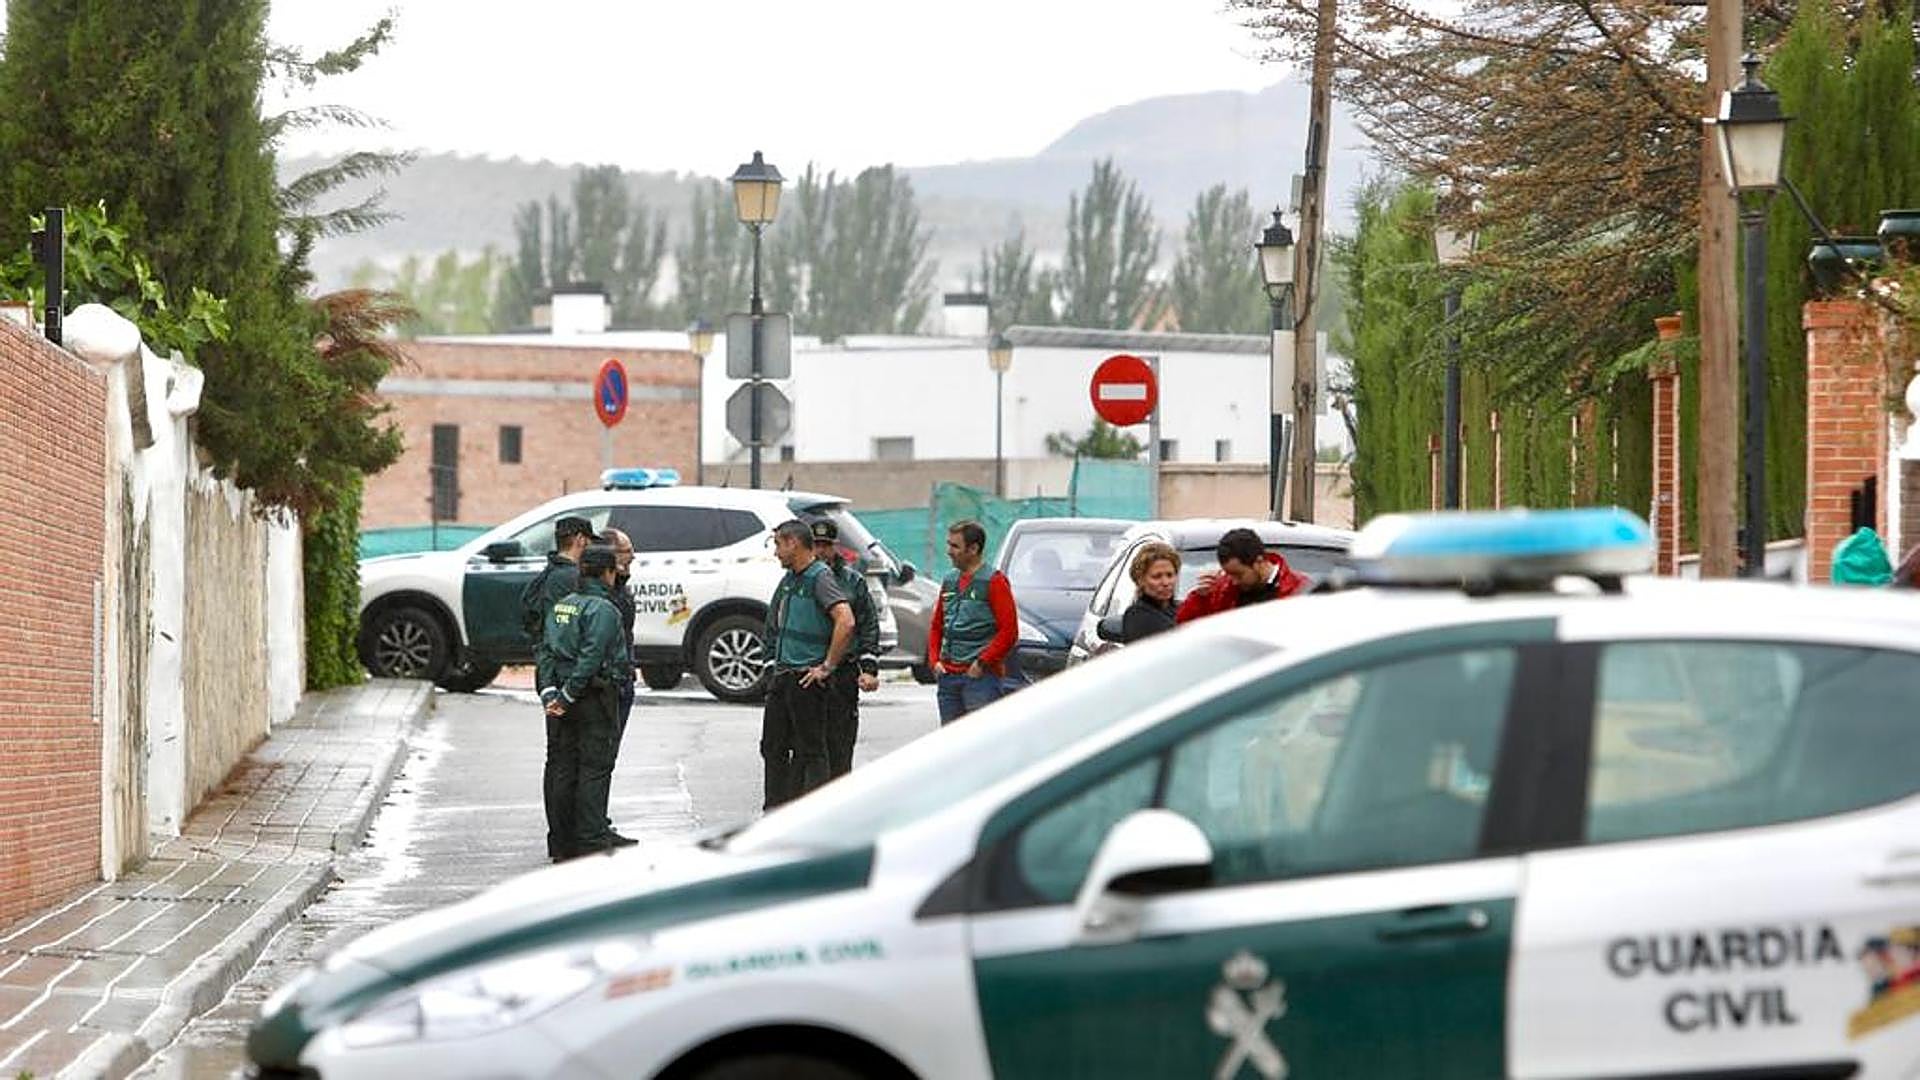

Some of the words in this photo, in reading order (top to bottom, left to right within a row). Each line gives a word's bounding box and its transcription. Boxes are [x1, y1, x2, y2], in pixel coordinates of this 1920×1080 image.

[629, 584, 684, 597] UARDIA
[1606, 921, 1844, 979] GUARDIA
[1663, 985, 1800, 1034] CIVIL
